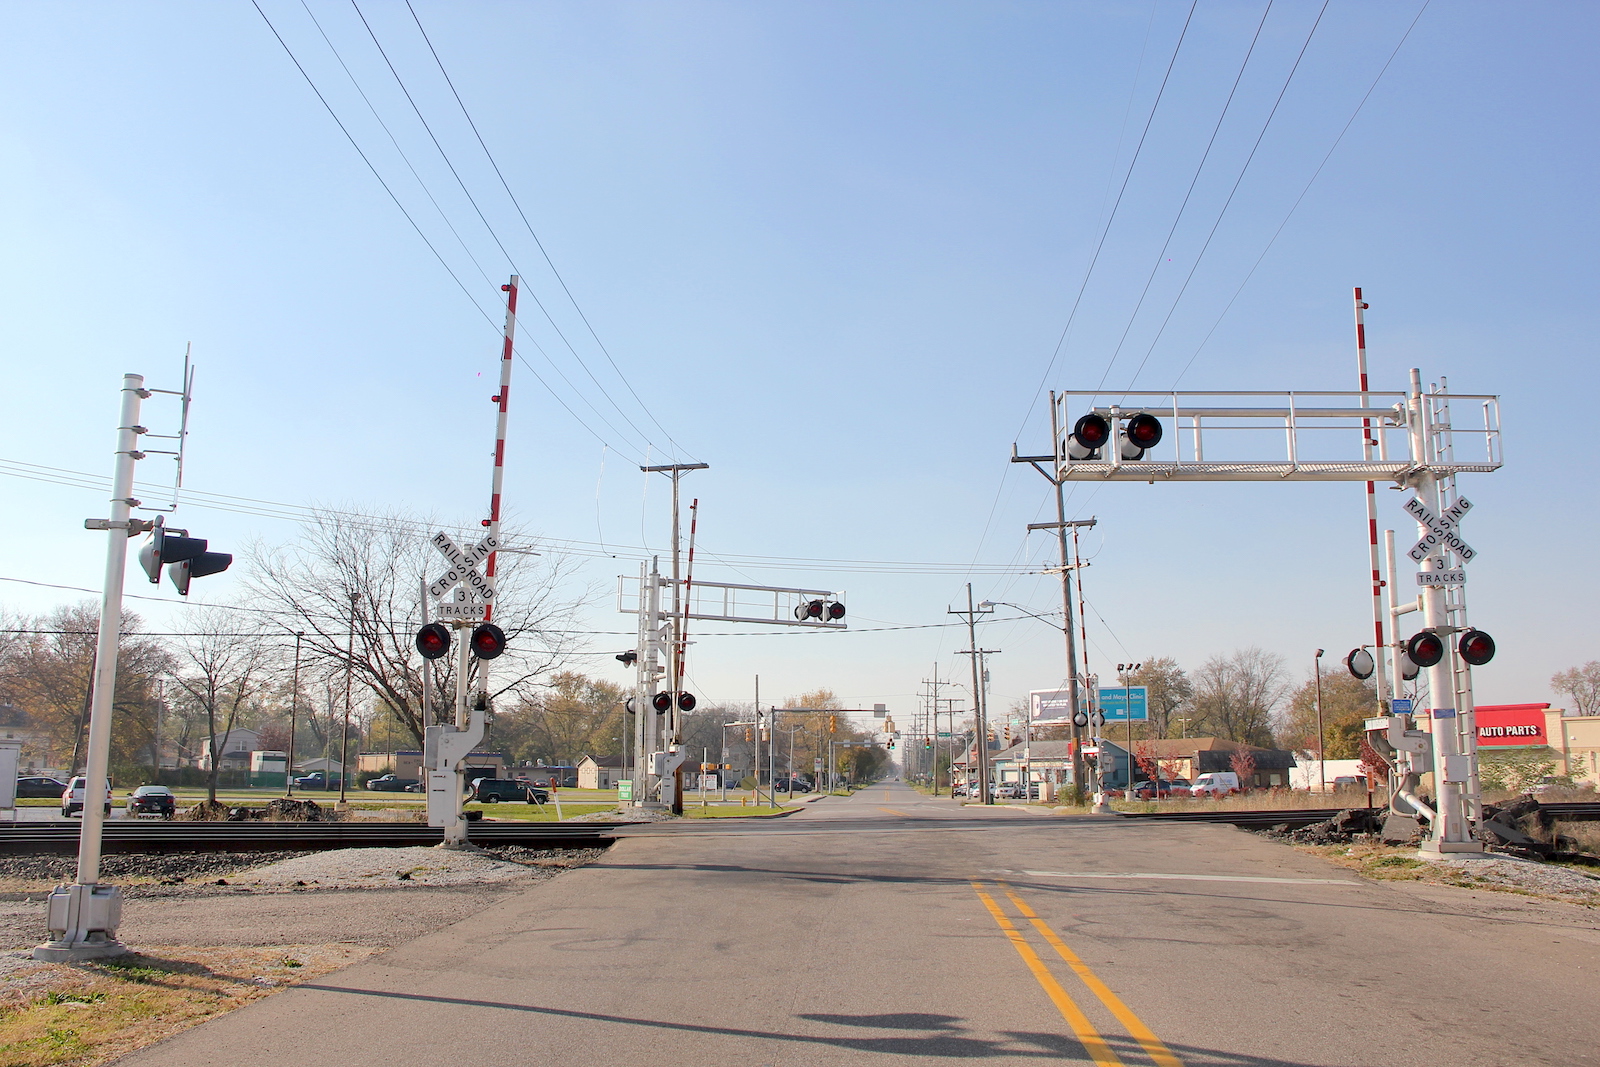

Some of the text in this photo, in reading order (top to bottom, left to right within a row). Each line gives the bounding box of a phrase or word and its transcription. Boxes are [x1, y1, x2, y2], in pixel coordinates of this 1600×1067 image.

[1407, 499, 1473, 560] RAILROAD
[1411, 499, 1470, 560] CROSSING
[430, 537, 497, 597] CROSSING
[434, 534, 494, 599] RAILROAD
[1436, 559, 1444, 570] 3
[1419, 573, 1465, 583] TRACKS
[458, 590, 466, 602] 3
[439, 606, 484, 615] TRACKS
[1480, 725, 1537, 737] AUTO PARTS
